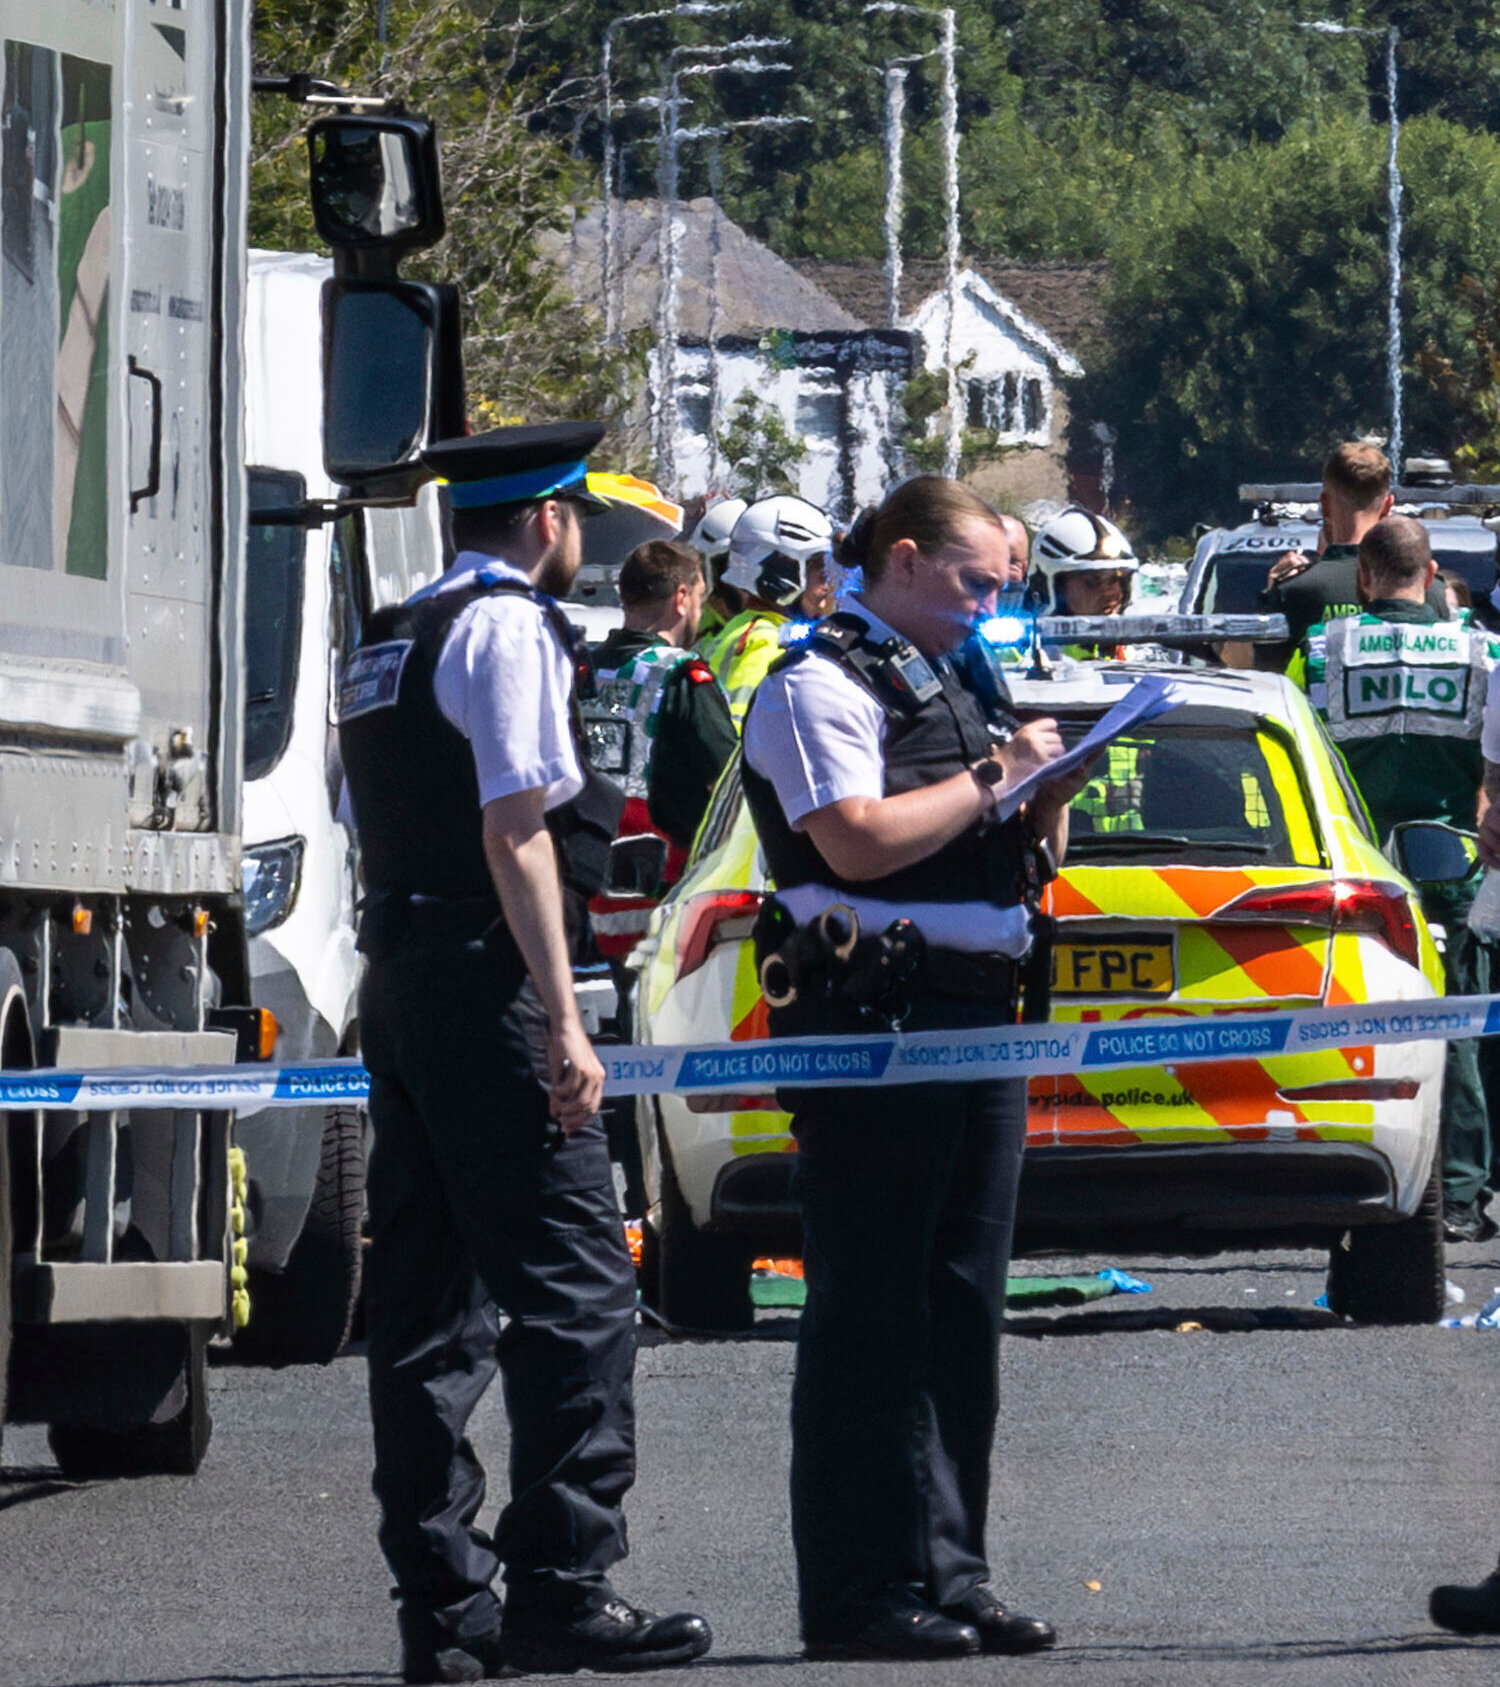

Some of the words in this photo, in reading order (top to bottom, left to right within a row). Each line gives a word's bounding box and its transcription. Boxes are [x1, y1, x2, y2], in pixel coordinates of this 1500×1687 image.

[1359, 634, 1457, 653] AMBULANCE
[1360, 674, 1458, 702] NILO
[1072, 950, 1154, 989] FPC
[1299, 1019, 1350, 1041] CROSS
[1355, 1017, 1386, 1035] NOT
[1015, 1039, 1070, 1061] POLICE
[1099, 1034, 1156, 1055] POLICE
[1159, 1032, 1179, 1050] DO
[1183, 1030, 1215, 1050] NOT
[1219, 1027, 1271, 1048] CROSS
[613, 1058, 664, 1080] POLICE
[694, 1056, 747, 1079] POLICE
[752, 1053, 776, 1074] DO
[780, 1053, 811, 1072] NOT
[815, 1051, 872, 1072] CROSS
[289, 1074, 346, 1094] POLICE
